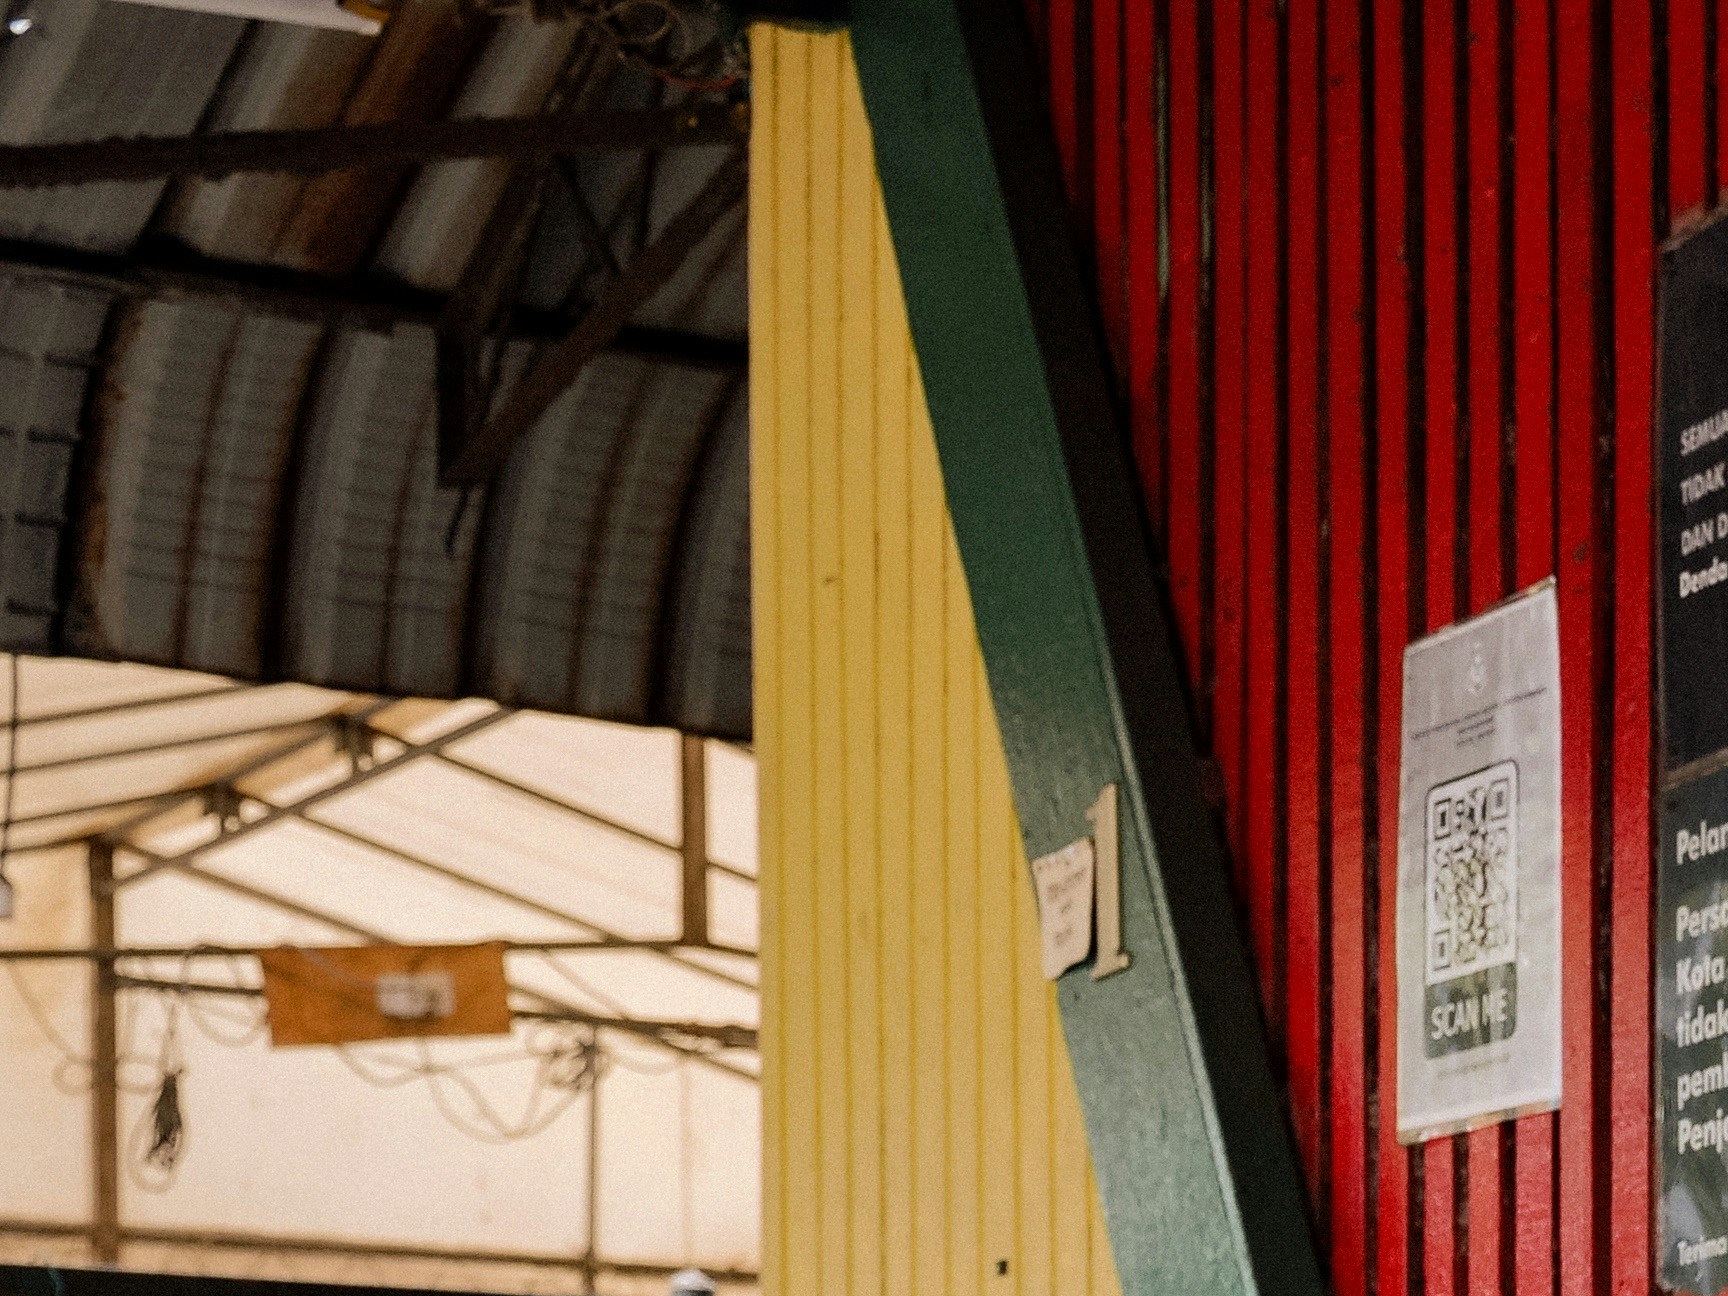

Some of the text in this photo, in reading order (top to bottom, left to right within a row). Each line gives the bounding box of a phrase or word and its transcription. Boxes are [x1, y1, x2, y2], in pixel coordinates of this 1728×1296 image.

[1680, 461, 1725, 505] TIDAK
[1681, 520, 1715, 556] DAN
[1679, 556, 1728, 599] Denda
[1676, 948, 1726, 996] Kota
[1431, 996, 1479, 1039] SCAN
[1677, 1235, 1728, 1266] Terima
